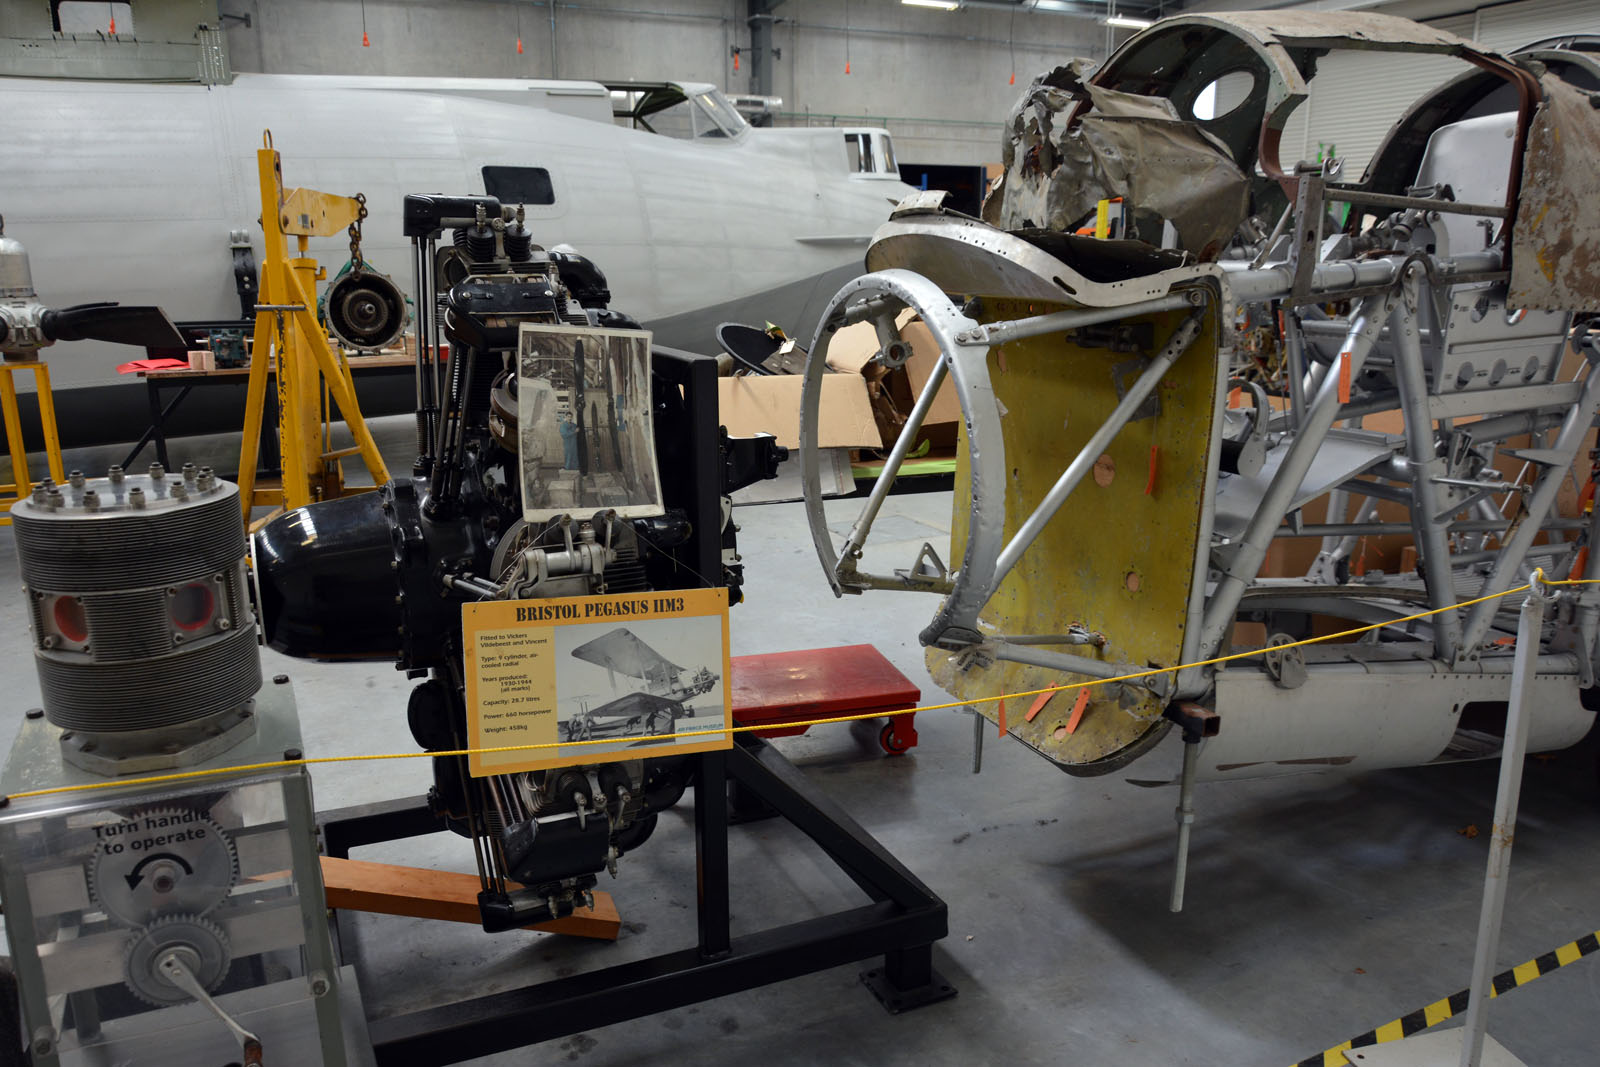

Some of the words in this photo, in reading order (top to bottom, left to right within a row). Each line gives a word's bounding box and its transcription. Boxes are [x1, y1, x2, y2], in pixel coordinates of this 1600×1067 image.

[516, 604, 581, 622] BRISTOL
[585, 600, 649, 617] PEGASUS
[499, 674, 528, 682] produced:
[483, 699, 510, 707] Capacity:
[518, 709, 552, 717] horsepower
[91, 821, 139, 839] Turn
[145, 808, 211, 830] handle
[104, 842, 124, 855] to
[130, 828, 206, 851] operate
